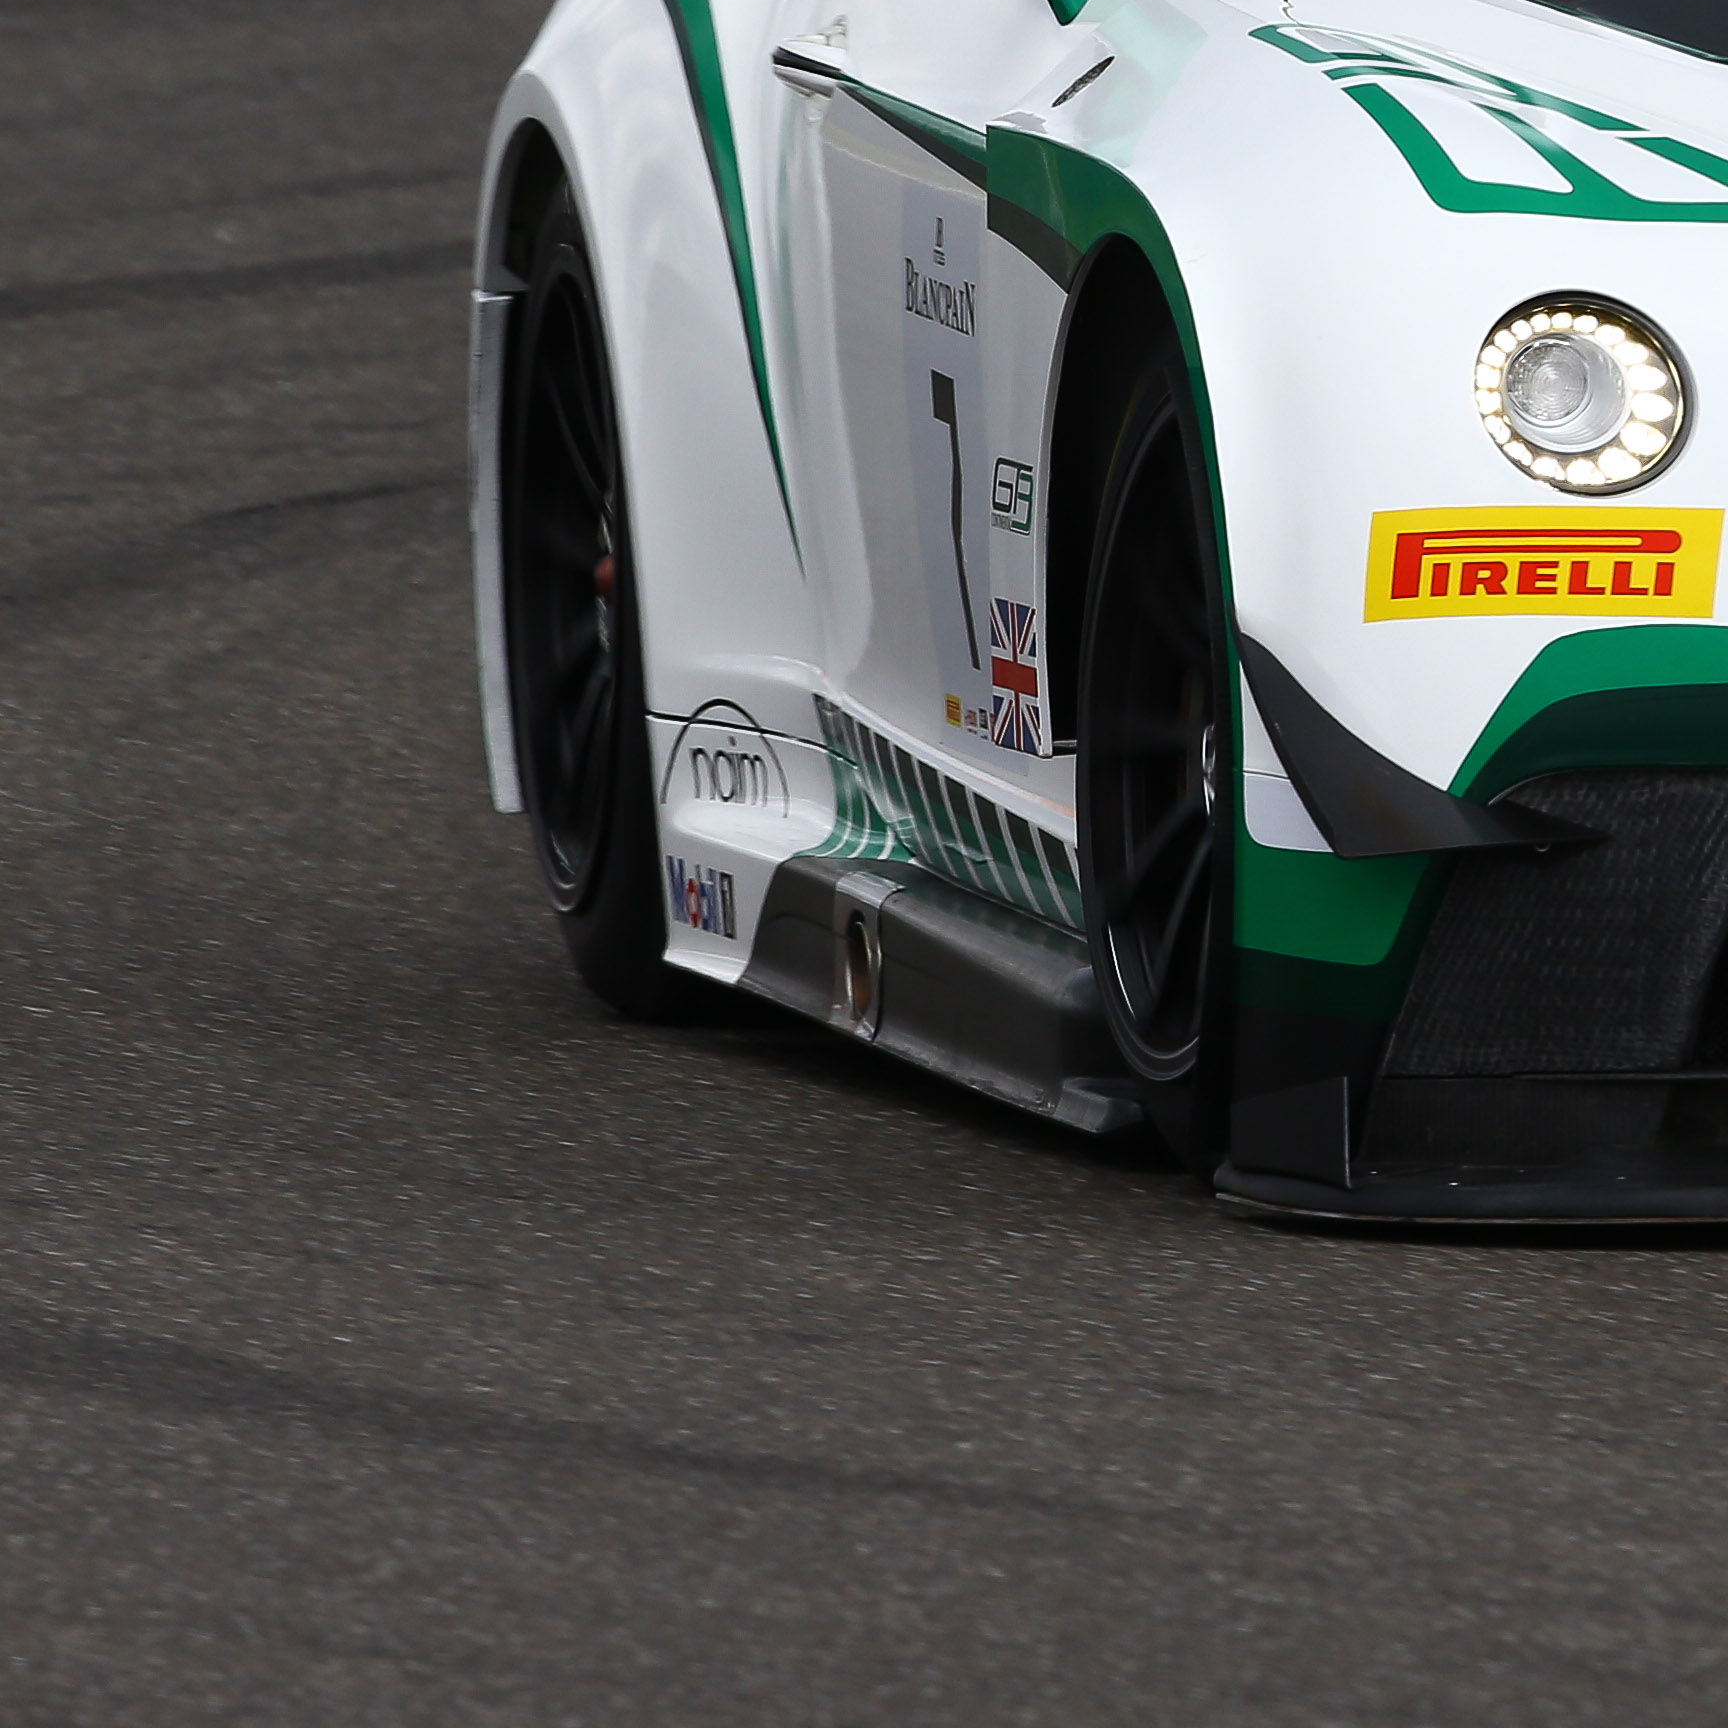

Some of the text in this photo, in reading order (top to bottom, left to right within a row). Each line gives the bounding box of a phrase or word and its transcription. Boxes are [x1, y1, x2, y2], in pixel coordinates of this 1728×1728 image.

[905, 256, 977, 337] BLANCPAIN
[930, 369, 982, 671] 7
[1389, 528, 1683, 600] PIRELLI
[688, 734, 769, 808] naim
